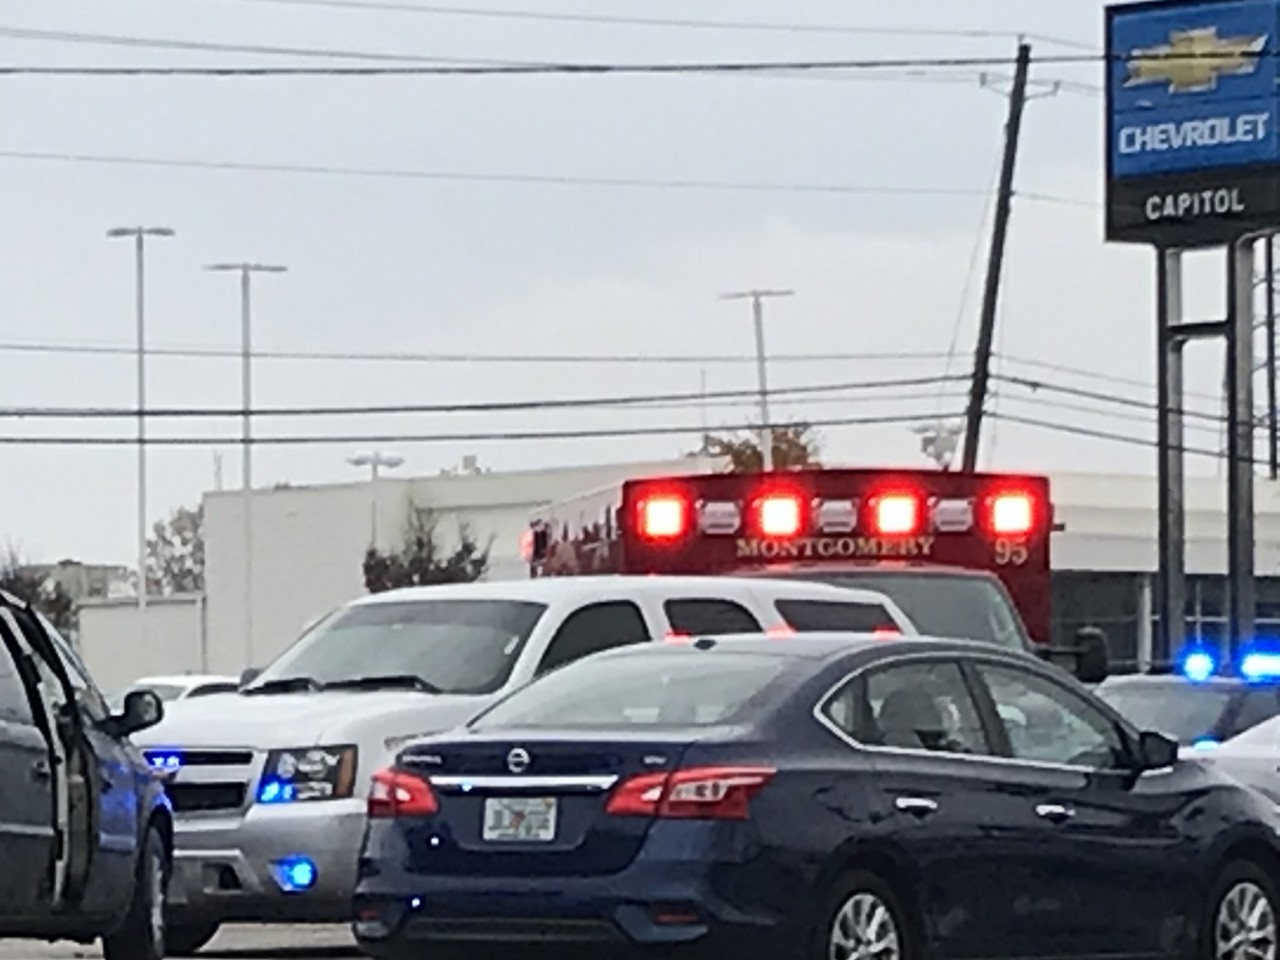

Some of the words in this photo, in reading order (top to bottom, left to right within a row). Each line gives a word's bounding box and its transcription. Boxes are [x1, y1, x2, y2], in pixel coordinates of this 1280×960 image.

[1119, 112, 1269, 154] CHEVROLET
[1145, 188, 1245, 220] CAPITOL
[735, 536, 936, 557] MONTGOMERY
[993, 537, 1029, 565] 95
